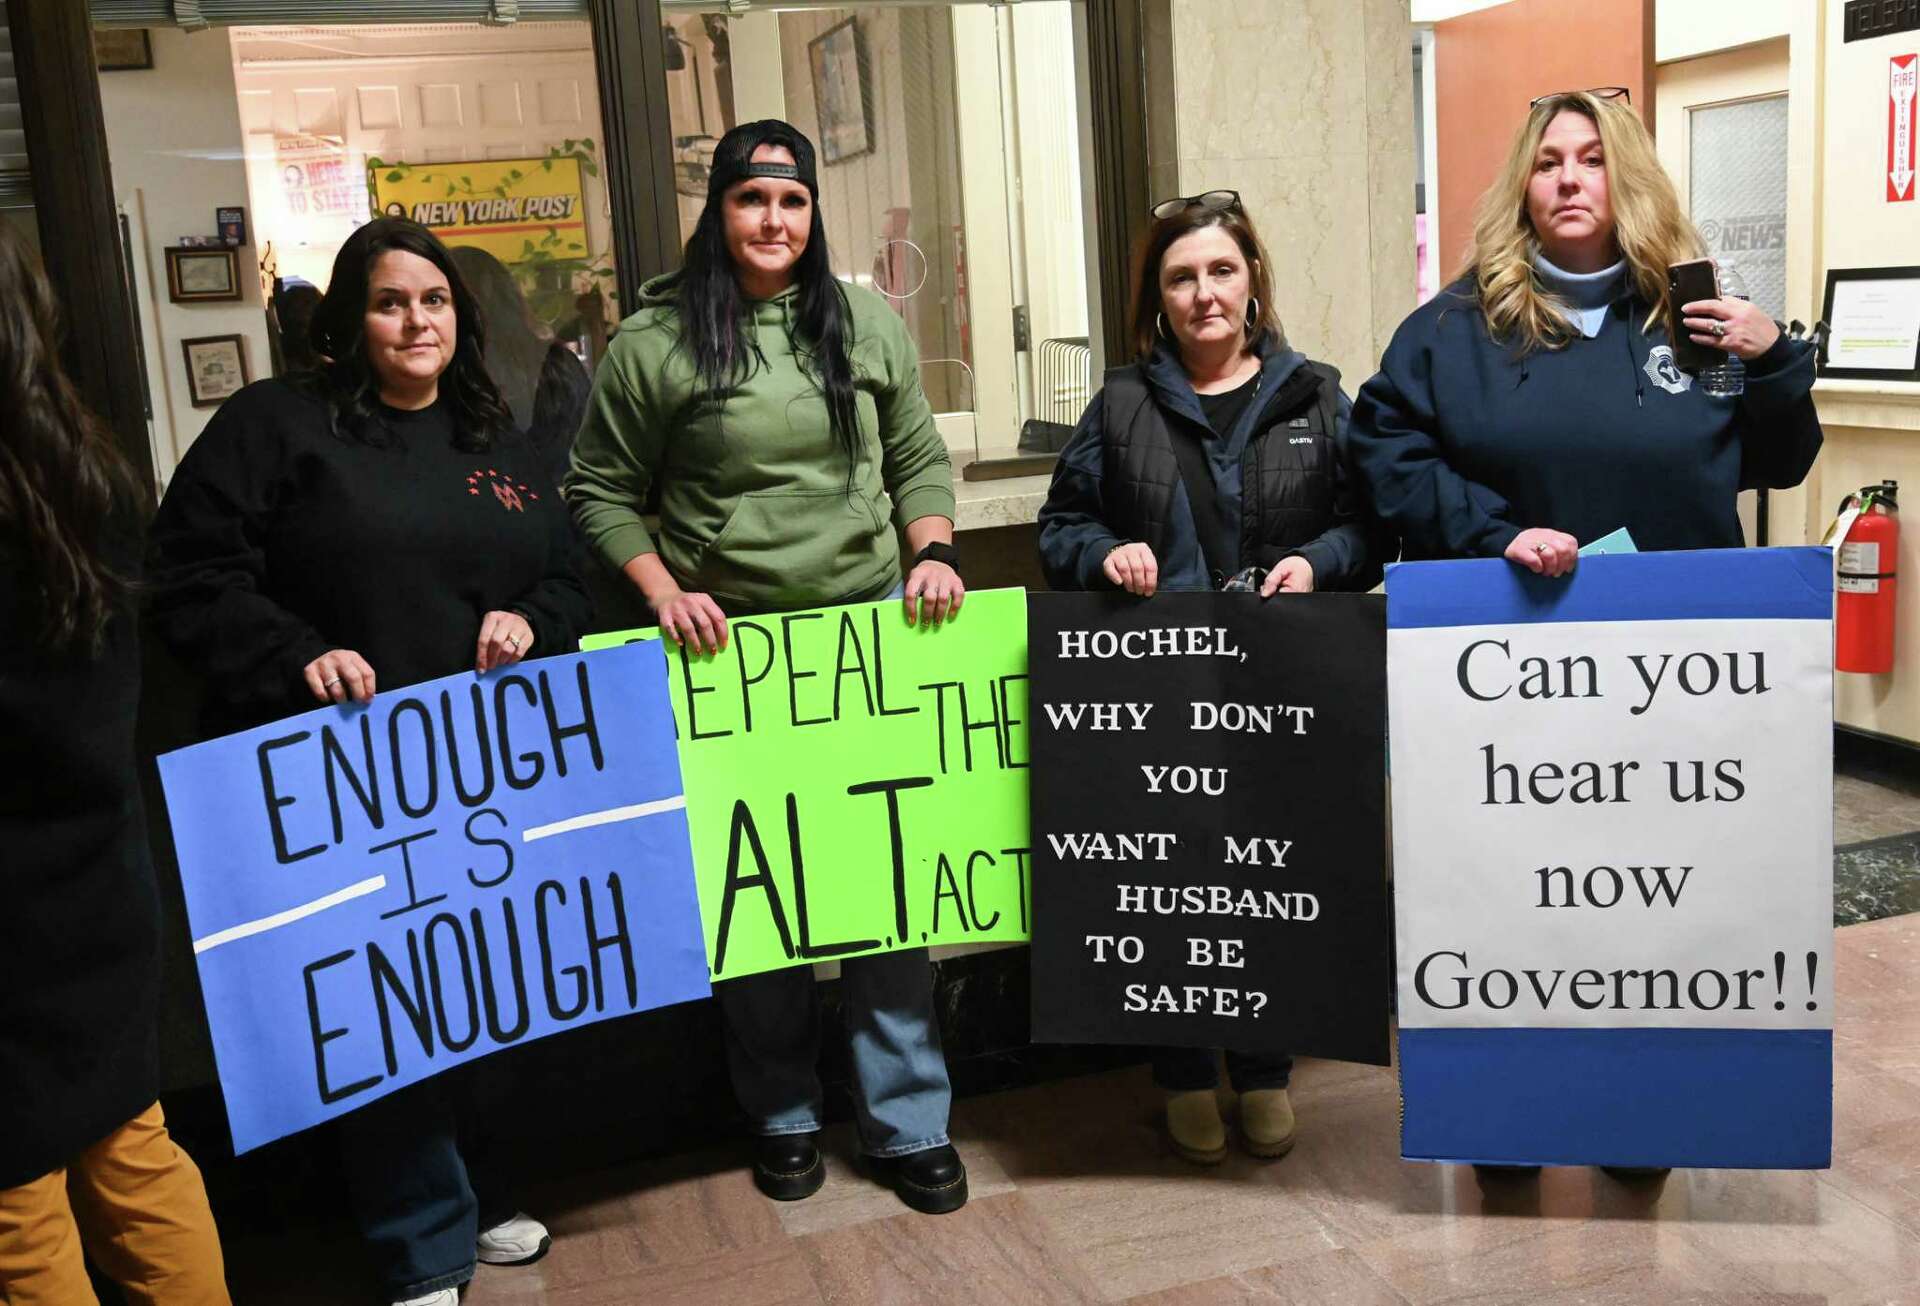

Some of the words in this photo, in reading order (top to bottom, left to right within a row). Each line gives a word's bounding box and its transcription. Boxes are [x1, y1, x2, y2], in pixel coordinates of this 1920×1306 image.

[1893, 71, 1914, 88] FIRE
[413, 201, 463, 226] NEW
[464, 196, 520, 225] YORK
[521, 193, 577, 220] POST
[1721, 223, 1786, 251] NEWS
[1057, 626, 1248, 663] HOCHEL,
[625, 608, 920, 741] EPEAL
[1456, 639, 1603, 702] Can
[1628, 650, 1772, 716] you
[918, 674, 1029, 774] THE
[1043, 702, 1154, 731] WHY
[1190, 702, 1314, 735] DON'T
[257, 661, 604, 864] ENOUGH
[1140, 765, 1229, 796] YOU
[1480, 743, 1640, 805] hear
[1664, 756, 1745, 803] us
[369, 808, 514, 919] IS
[1046, 832, 1177, 861] WANT
[1224, 836, 1293, 868] MY
[708, 777, 928, 975] A.L.T.
[932, 848, 1031, 935] ACT
[1534, 865, 1694, 909] now
[1116, 884, 1320, 922] HUSBAND
[1085, 935, 1145, 964] TO
[1186, 937, 1245, 969] BE
[303, 871, 638, 1105] ENOUGH
[1124, 984, 1268, 1018] SAFE?
[1413, 950, 1818, 1012] Governor!!
